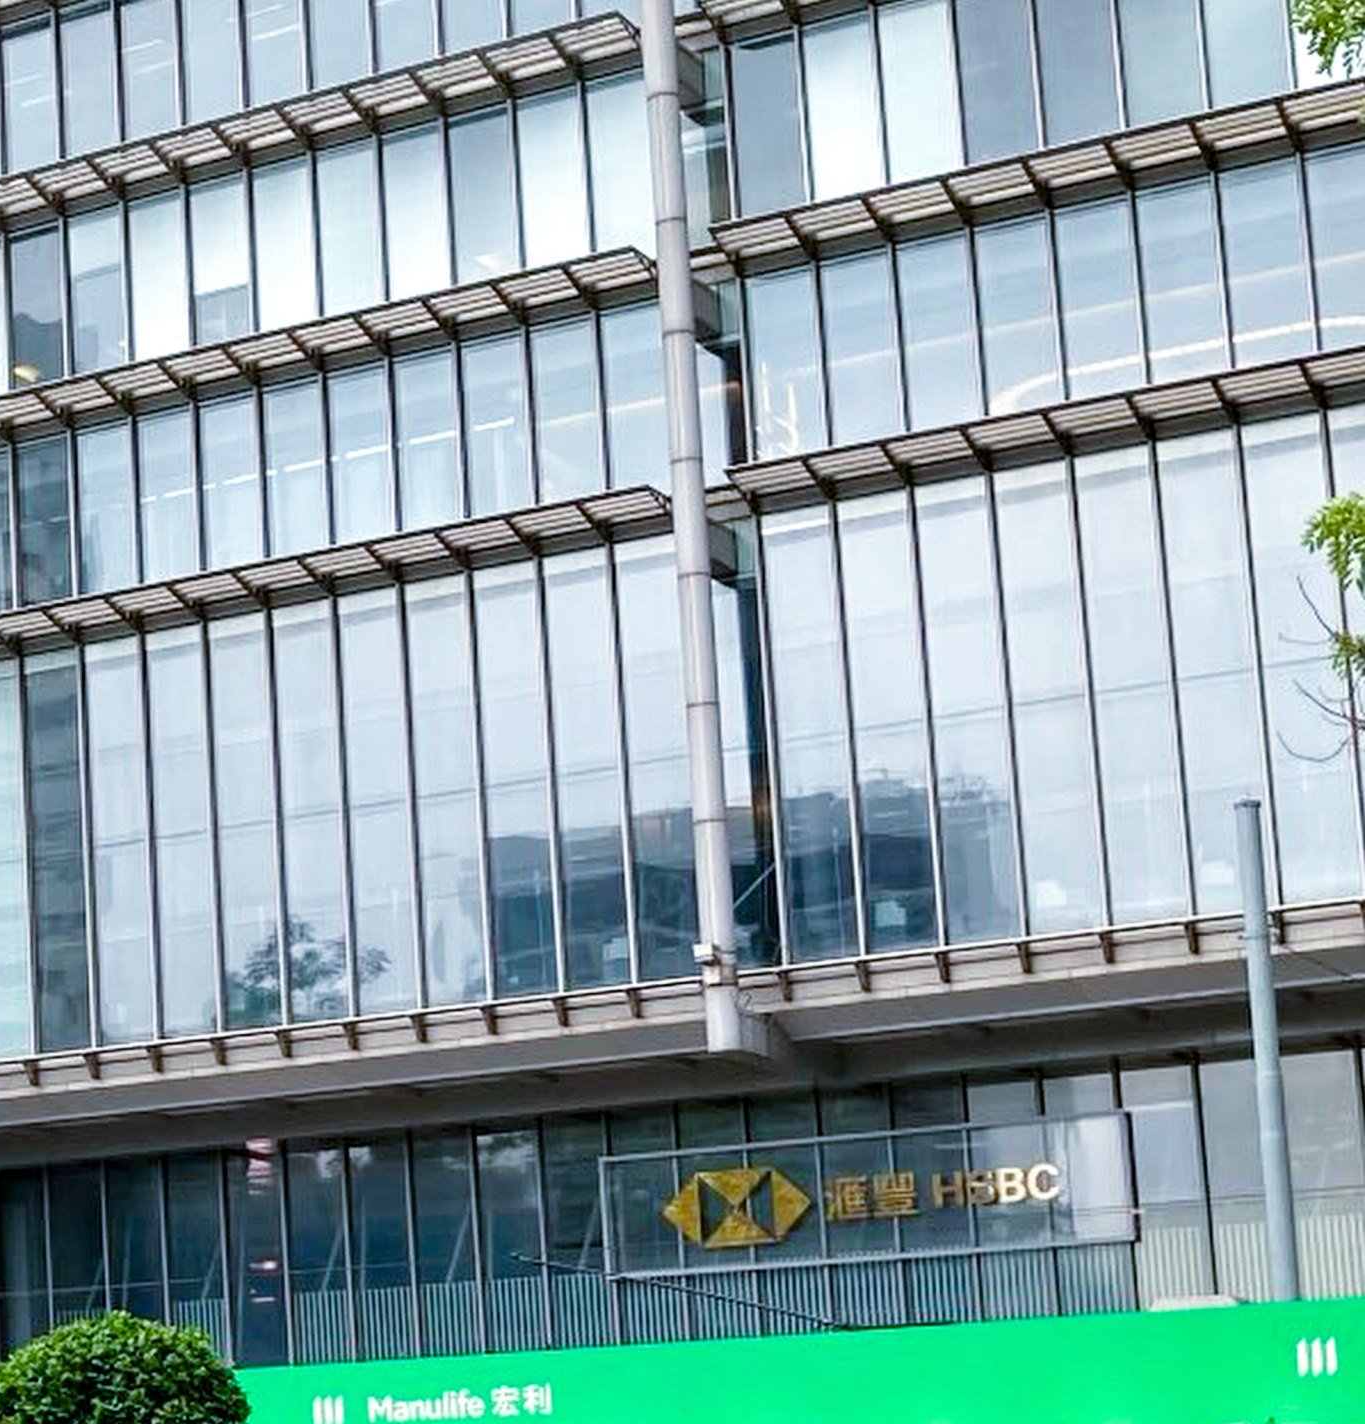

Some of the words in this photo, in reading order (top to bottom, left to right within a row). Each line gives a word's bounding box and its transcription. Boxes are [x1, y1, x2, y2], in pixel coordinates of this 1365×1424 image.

[932, 1163, 1061, 1208] HSBC
[366, 1388, 486, 1423] Manulife
[490, 1382, 553, 1417] 宏利
